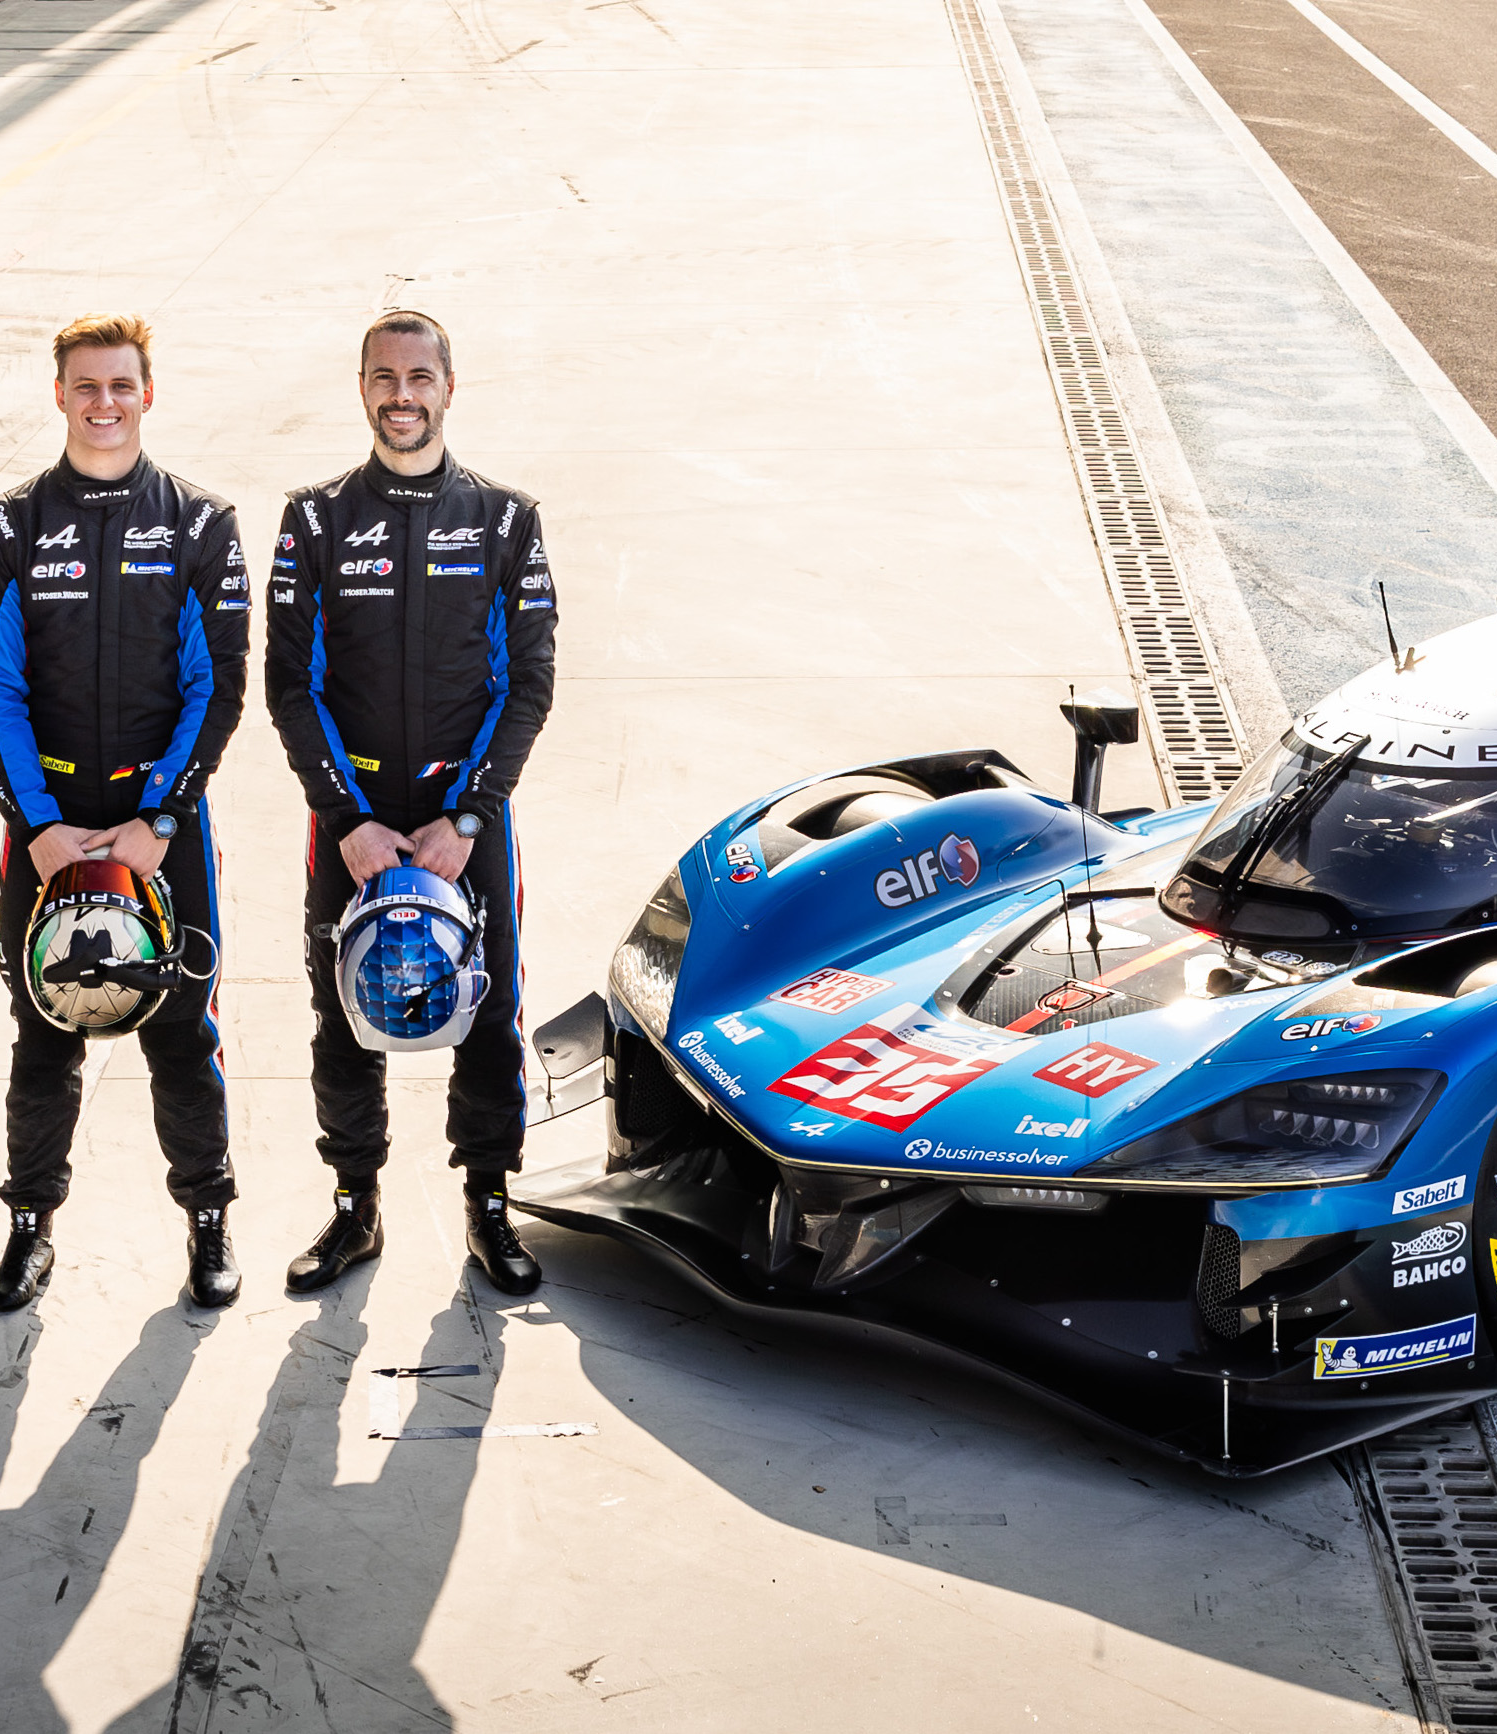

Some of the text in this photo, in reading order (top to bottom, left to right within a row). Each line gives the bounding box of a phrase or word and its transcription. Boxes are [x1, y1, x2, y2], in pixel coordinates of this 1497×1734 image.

[83, 489, 130, 500] ALPINE
[388, 488, 433, 498] ALPINE
[189, 503, 215, 540] Sabelt
[302, 500, 323, 536] Sabelt
[497, 499, 519, 538] Sabelt
[124, 525, 176, 542] WEC
[427, 527, 485, 542] WEC
[32, 564, 66, 579] elf
[137, 565, 173, 573] MICHELIN
[341, 560, 374, 575] elf
[221, 577, 241, 590] elf
[521, 575, 544, 589] elf
[39, 756, 70, 771] Sabelt
[351, 756, 375, 769] abelt
[725, 842, 752, 869] elf
[876, 851, 939, 907] elf
[44, 892, 144, 915] ALPINE
[368, 896, 447, 910] ALPINE
[391, 911, 417, 919] BELL
[805, 968, 883, 996] HYPER
[779, 982, 856, 1013] CAR
[713, 1012, 766, 1046] ixell
[1281, 1018, 1346, 1040] elf
[688, 1038, 747, 1100] businessolver
[783, 1036, 990, 1117] 35
[1044, 1047, 1146, 1089] HY
[1013, 1115, 1091, 1139] ixell
[933, 1140, 1069, 1166] businessolver
[1402, 1179, 1459, 1209] Sabelt
[1393, 1257, 1466, 1288] BAHCO
[1364, 1329, 1472, 1364] MICHELIN
